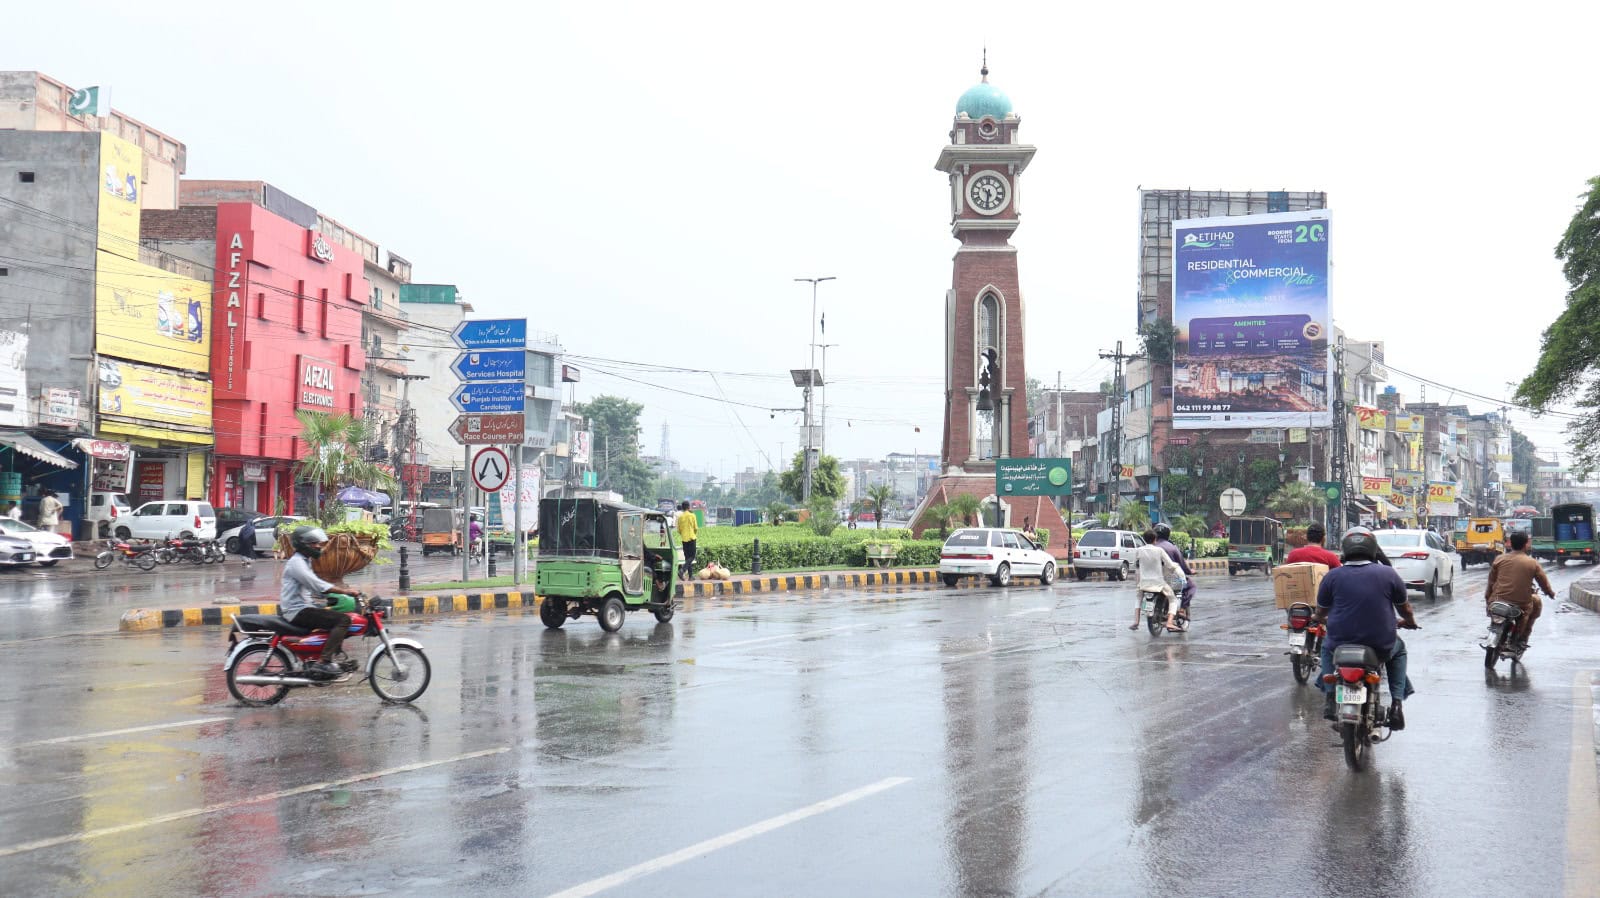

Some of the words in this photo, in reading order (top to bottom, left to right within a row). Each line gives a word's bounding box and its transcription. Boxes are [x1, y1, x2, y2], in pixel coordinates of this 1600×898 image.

[1199, 231, 1234, 241] ETIHAD
[1187, 259, 1256, 271] RESIDENTIAL
[1233, 267, 1307, 279] COMMERCIAL
[227, 233, 243, 327] AFZAL
[304, 364, 334, 391] AFZAL
[466, 370, 495, 378] Services
[496, 369, 524, 378] Hospital
[303, 391, 334, 408] ELECTRONICS
[463, 432, 480, 440] Race
[482, 432, 507, 440] Course
[508, 432, 523, 440] Park
[1121, 467, 1132, 477] 20
[1364, 482, 1381, 490] 20
[1395, 477, 1408, 486] 20
[1430, 486, 1444, 496] 20
[1391, 493, 1404, 505] 20
